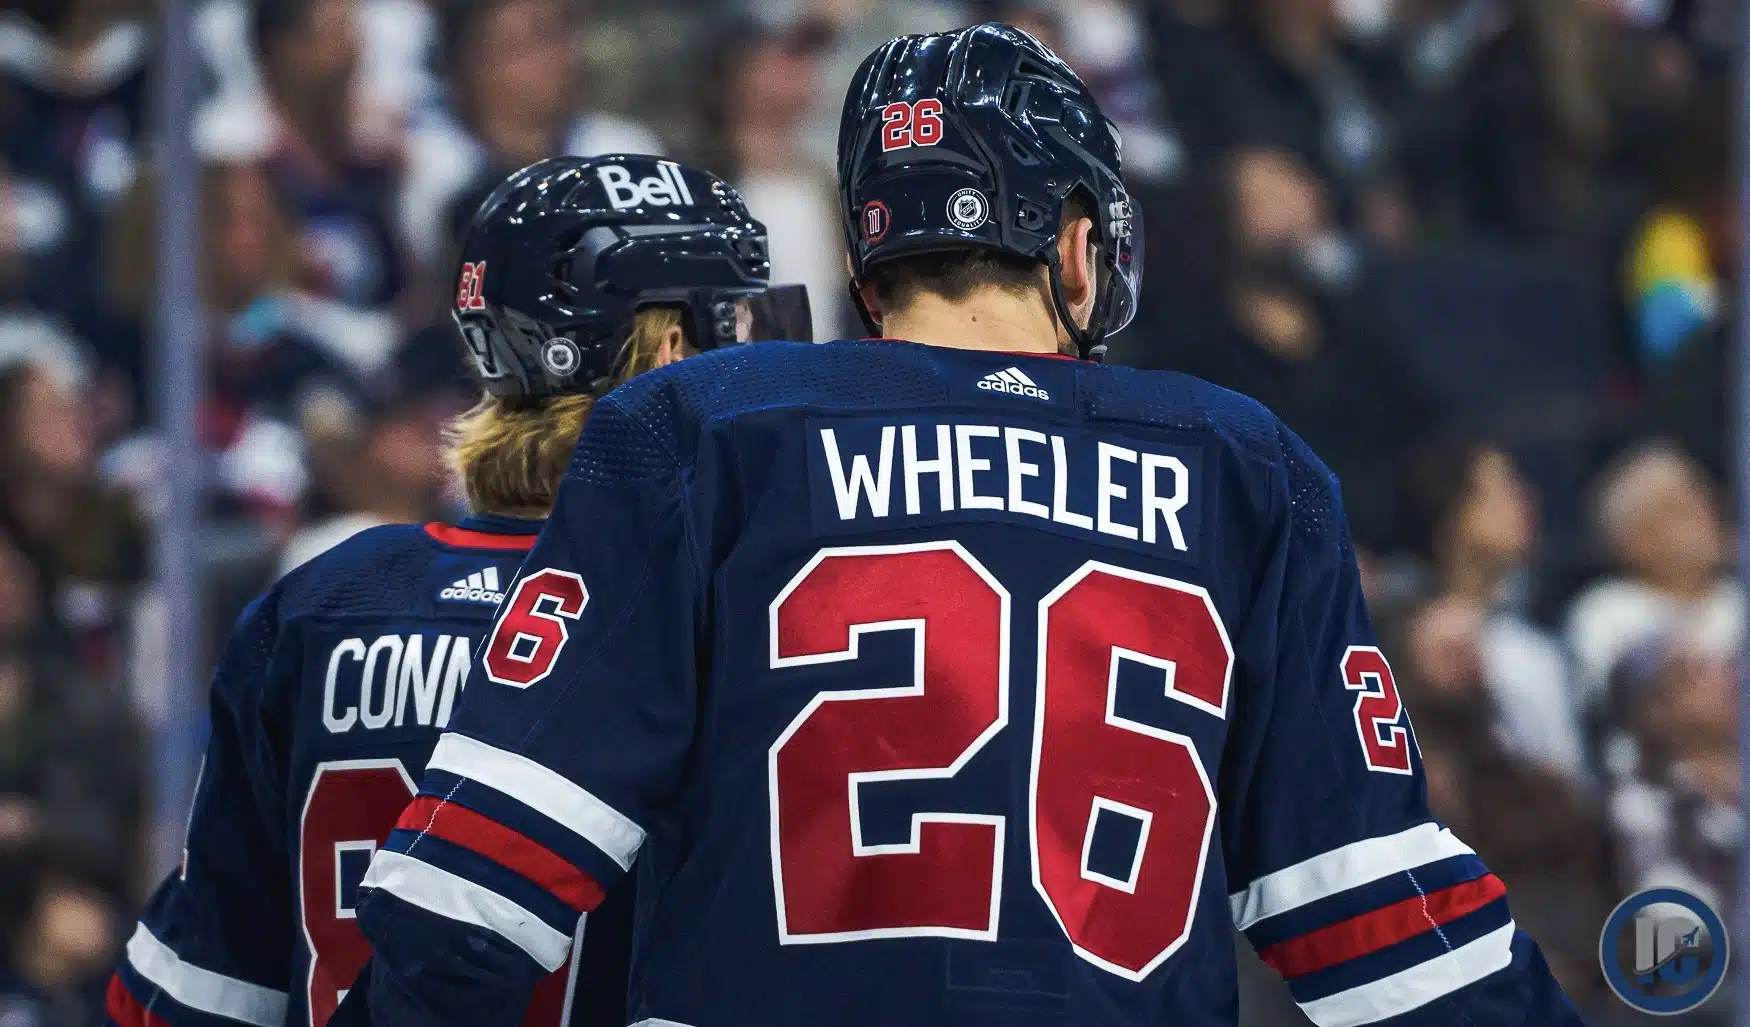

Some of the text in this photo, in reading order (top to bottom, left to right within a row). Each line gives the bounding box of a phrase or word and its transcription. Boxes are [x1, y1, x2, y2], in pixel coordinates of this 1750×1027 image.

[882, 97, 943, 152] 26
[597, 162, 694, 210] Bell
[868, 208, 880, 234] 11
[953, 217, 983, 228] EQUALITY
[457, 260, 486, 310] 81
[976, 379, 1050, 401] adidas
[819, 424, 1189, 552] WHEELER
[440, 584, 505, 604] adidas
[474, 567, 590, 690] 6
[1340, 645, 1422, 776] 2
[768, 540, 1235, 983] 26
